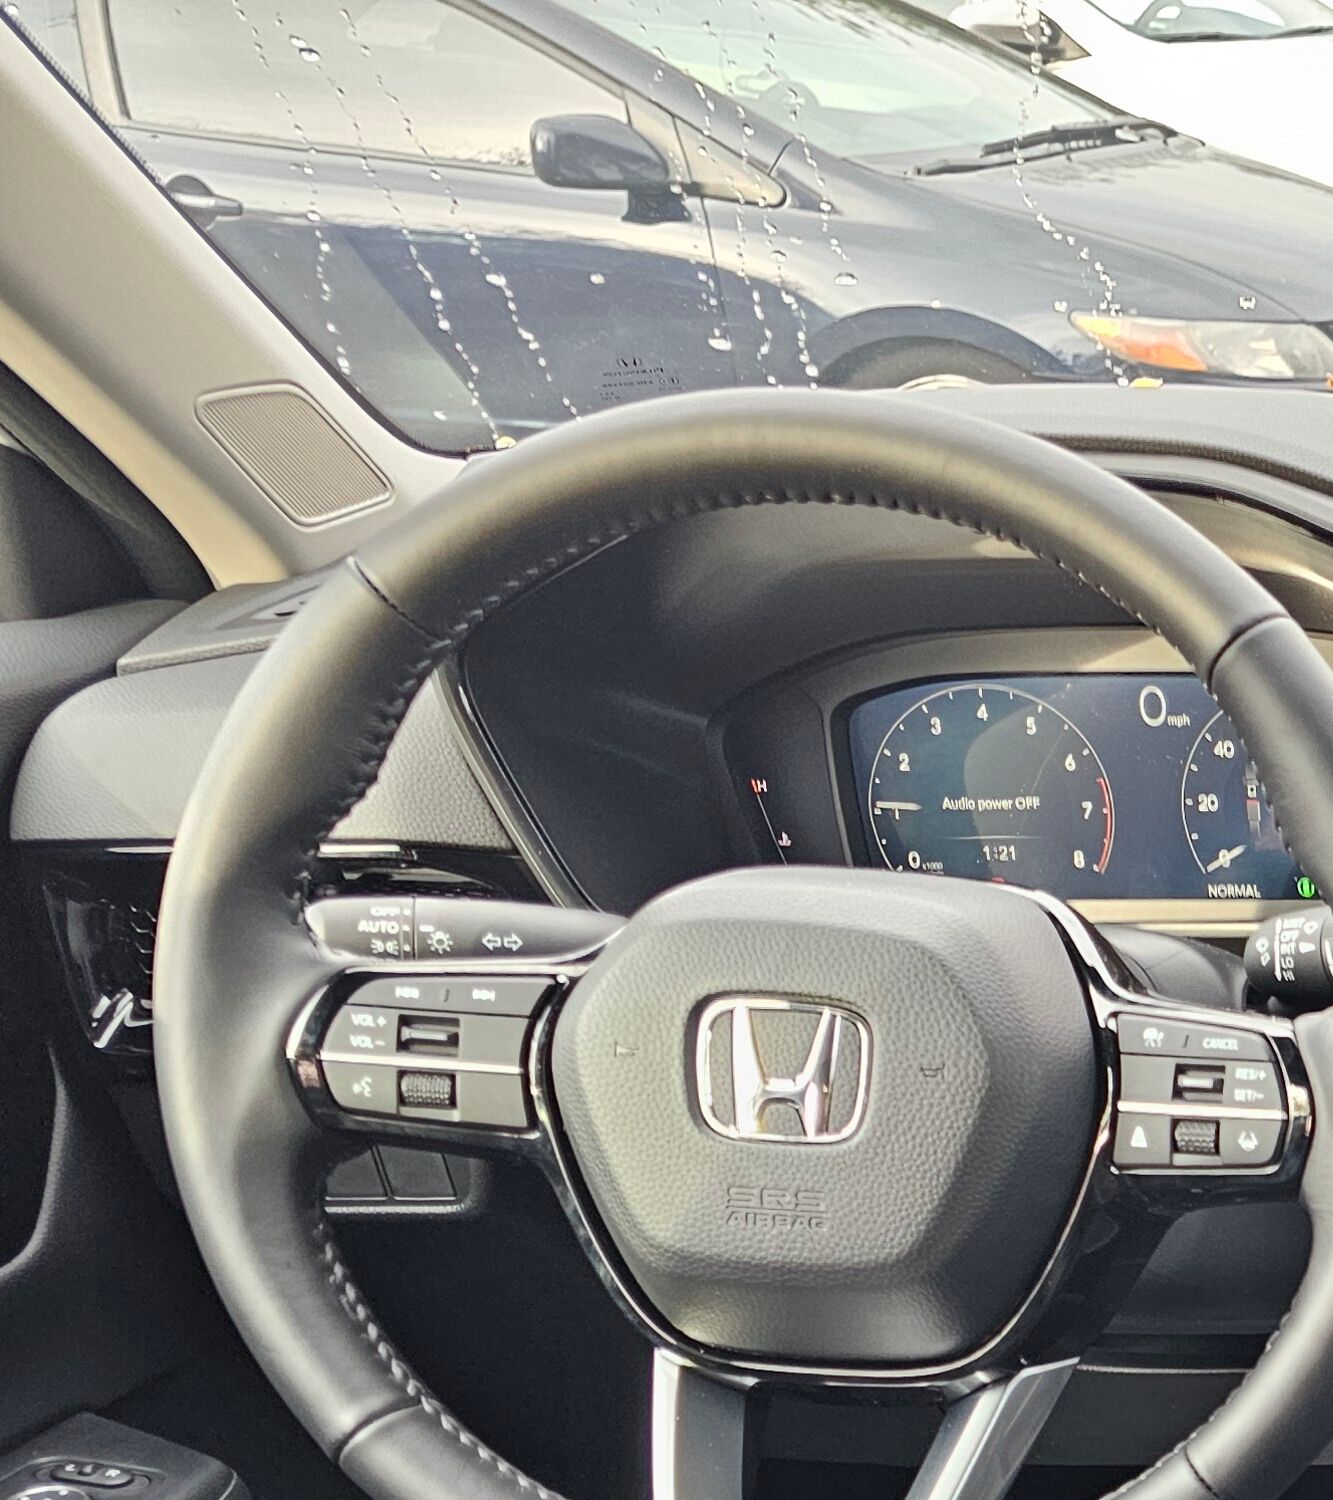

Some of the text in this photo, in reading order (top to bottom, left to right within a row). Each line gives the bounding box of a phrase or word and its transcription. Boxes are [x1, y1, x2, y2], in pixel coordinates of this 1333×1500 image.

[977, 703, 989, 721] 4
[1139, 686, 1191, 728] 0 mph
[930, 717, 942, 735] 3
[1026, 717, 1037, 735] 5
[1213, 739, 1235, 758] 40
[898, 753, 911, 772] 2
[1065, 753, 1077, 772] 6
[942, 796, 1041, 813] Audio power OFF
[1081, 801, 1094, 820] 7
[1198, 793, 1219, 812] 20
[908, 851, 921, 870] 0
[982, 844, 1016, 861] 1:21
[1073, 850, 1085, 869] 8
[1207, 884, 1262, 899] NORMAL
[357, 919, 400, 935] AUTO
[350, 1013, 376, 1028] VOL
[349, 1034, 375, 1050] VOL
[724, 1187, 828, 1213] SRS
[724, 1211, 830, 1234] AIRBAG
